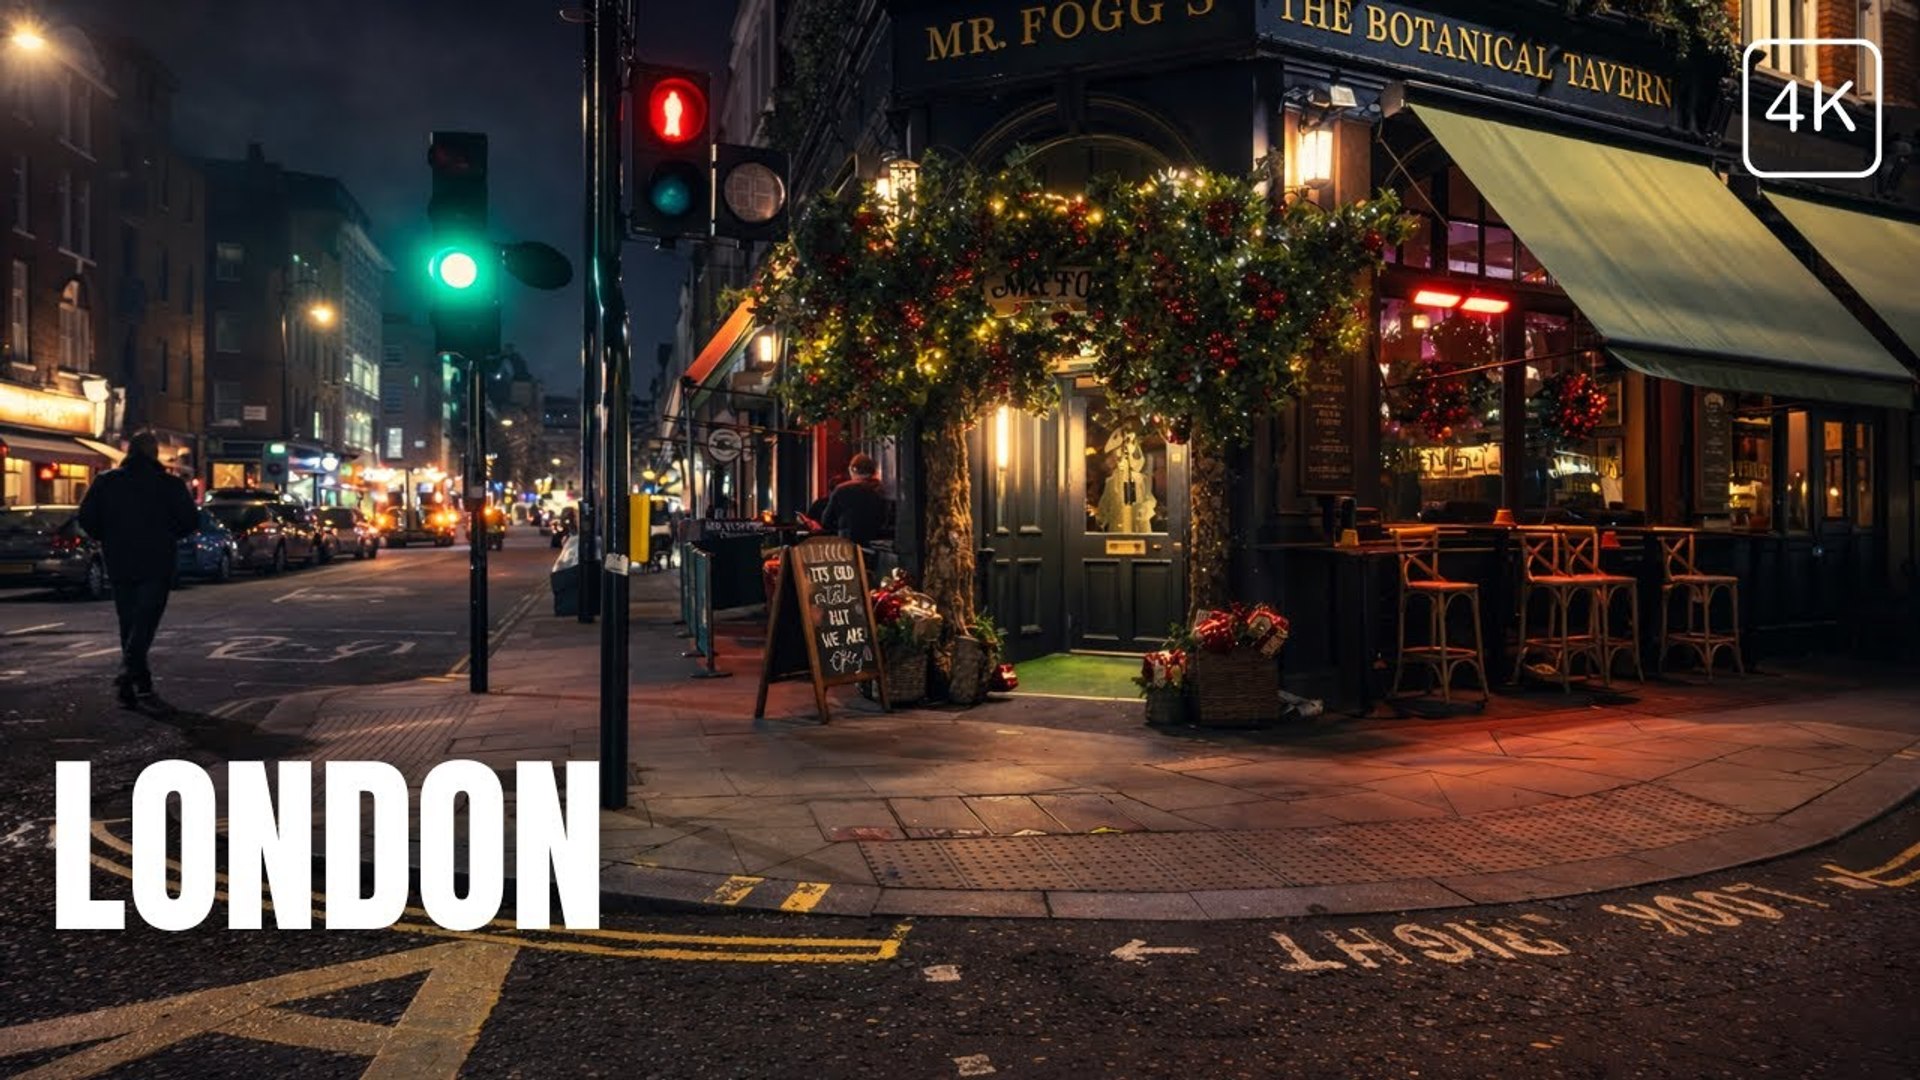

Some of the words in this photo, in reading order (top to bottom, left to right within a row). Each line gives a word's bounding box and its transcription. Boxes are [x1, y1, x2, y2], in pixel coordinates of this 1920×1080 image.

[925, 17, 1007, 61] MR.
[1020, 0, 1215, 45] FOGG
[1366, 4, 1553, 80] BOTANICAL
[1563, 53, 1672, 108] TAVERN
[1602, 883, 1830, 937] LOOK
